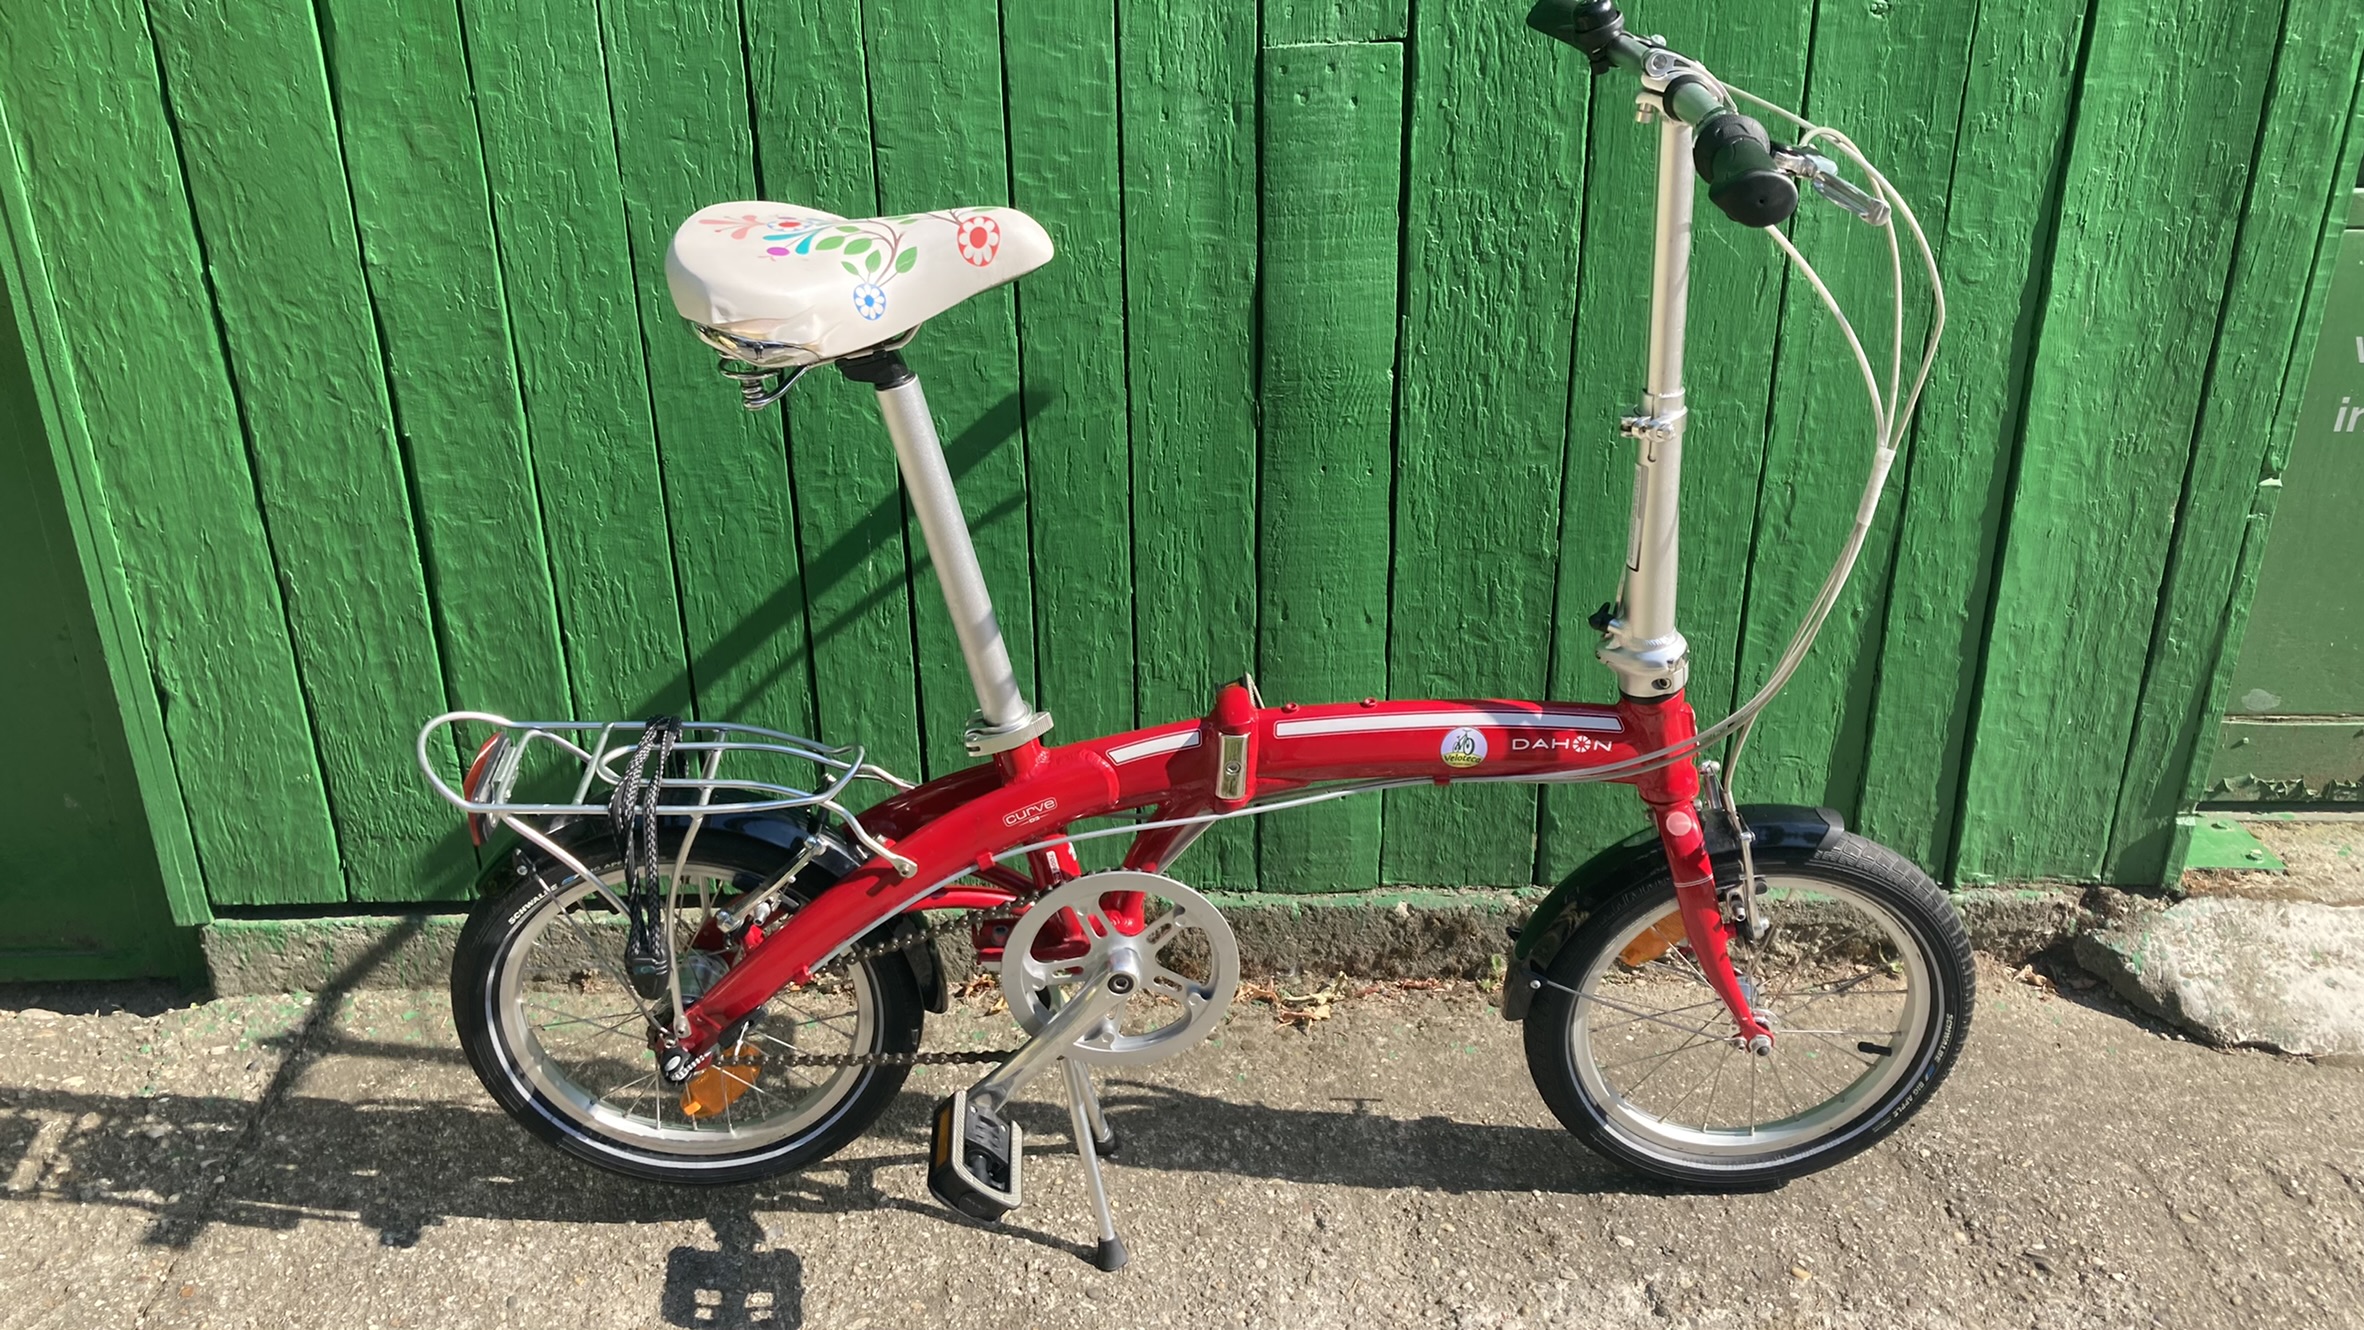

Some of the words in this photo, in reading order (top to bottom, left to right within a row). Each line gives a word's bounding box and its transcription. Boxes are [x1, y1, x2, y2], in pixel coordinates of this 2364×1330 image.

[1512, 735, 1612, 753] DAHON
[1444, 754, 1482, 764] Veloteca
[1005, 799, 1055, 824] curve
[507, 883, 559, 926] SCHWALE
[1934, 1012, 1954, 1064] SCHWALBE
[1911, 1081, 1926, 1096] BIG
[1892, 1095, 1914, 1118] APPLE
